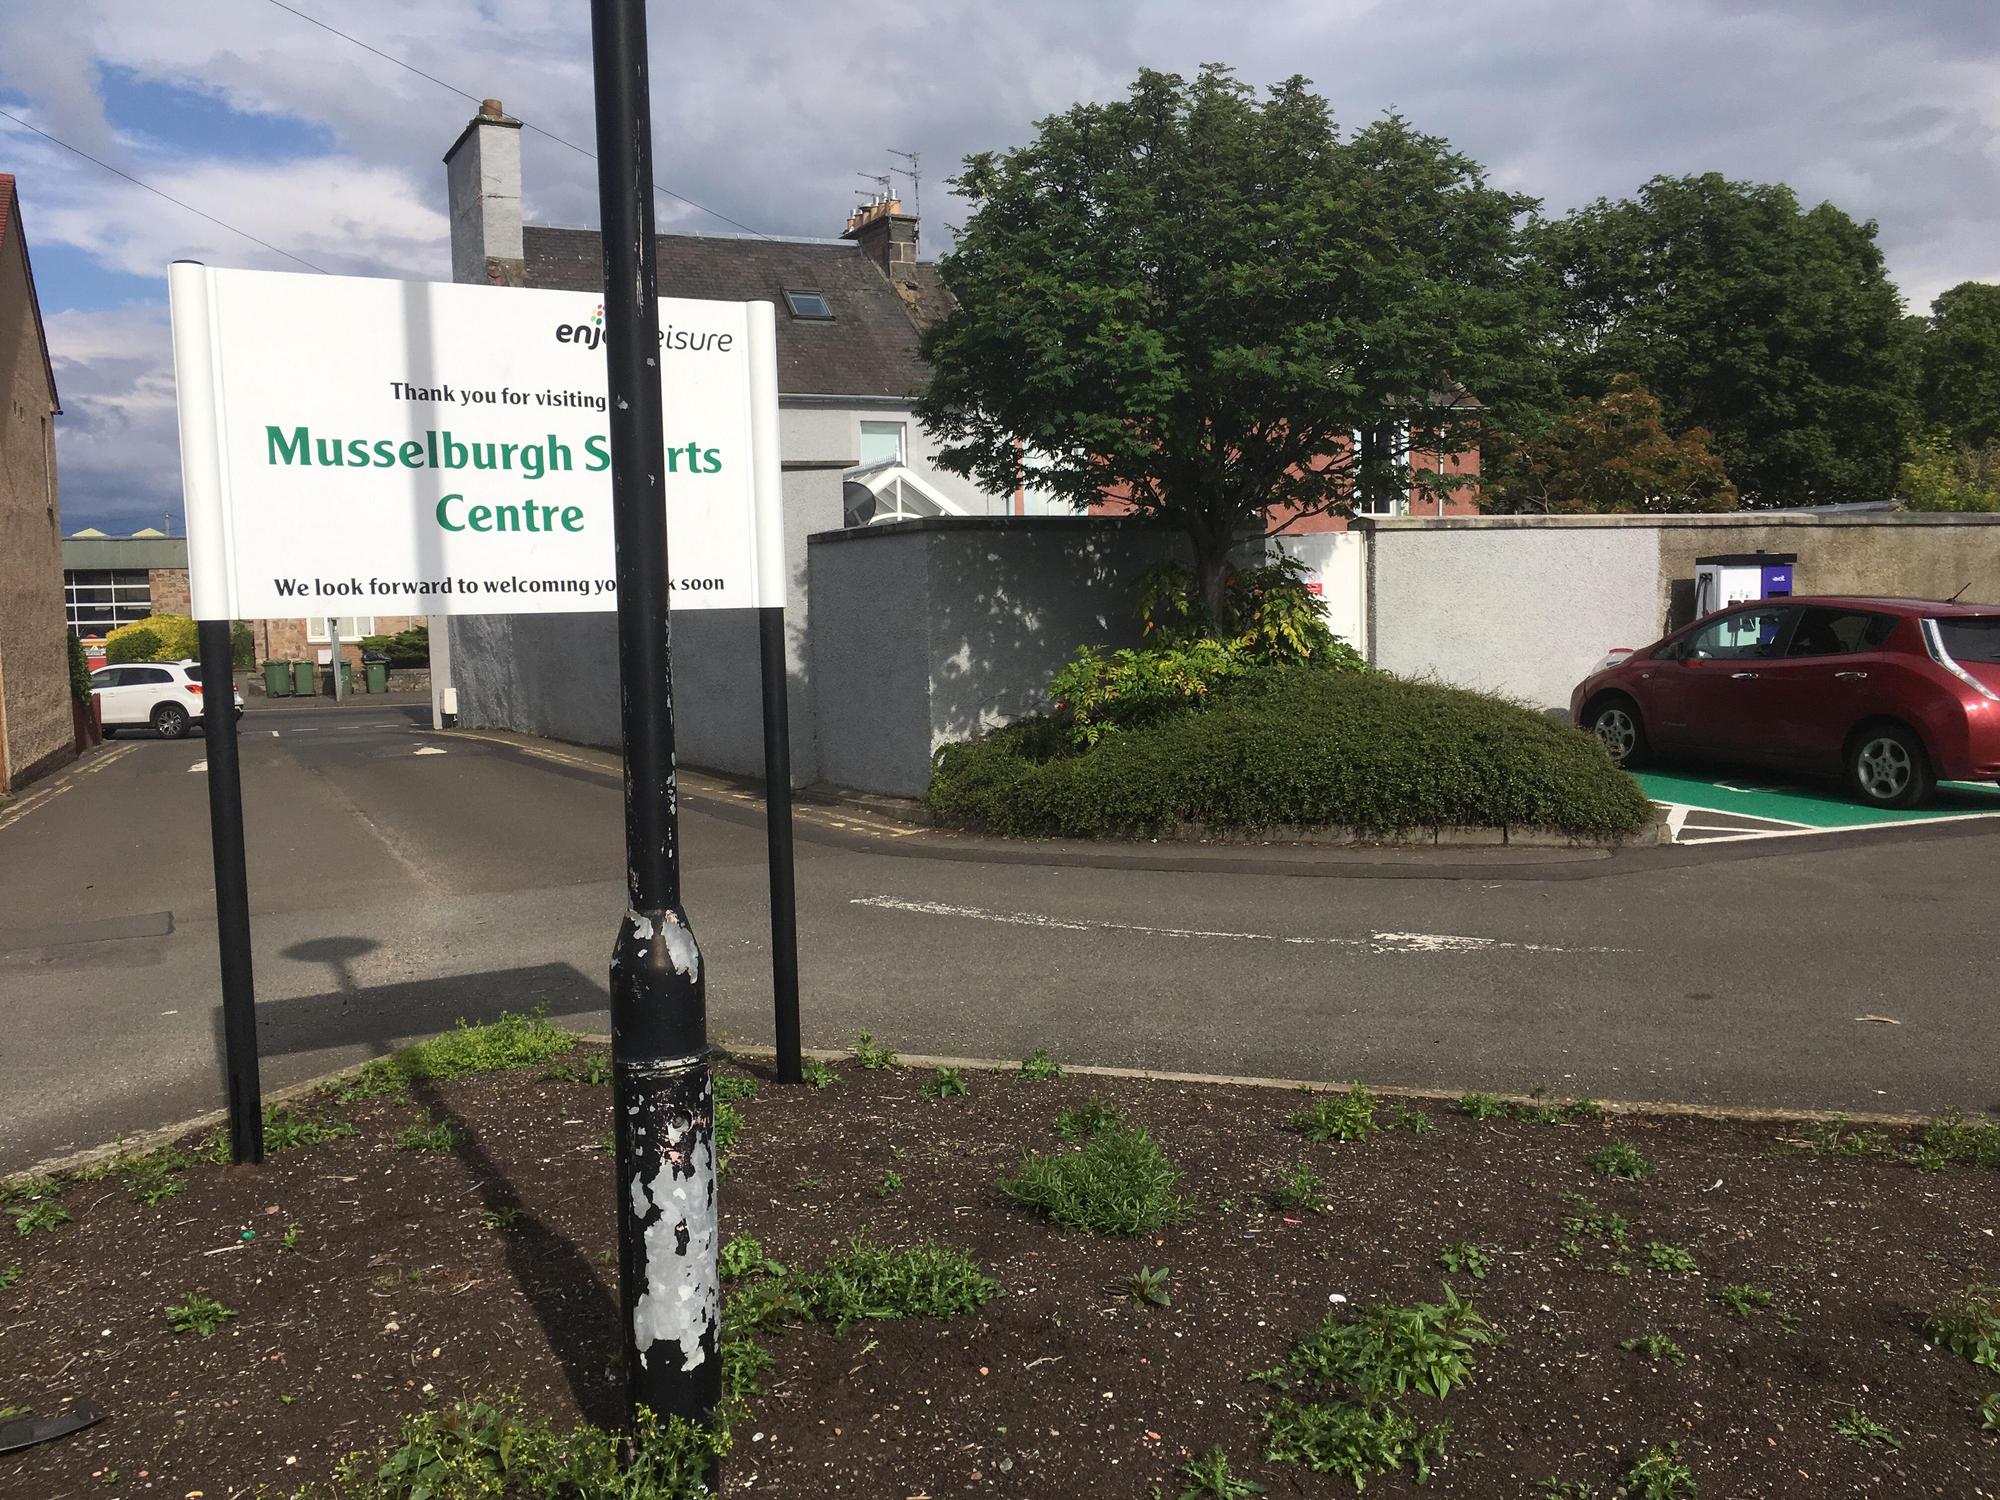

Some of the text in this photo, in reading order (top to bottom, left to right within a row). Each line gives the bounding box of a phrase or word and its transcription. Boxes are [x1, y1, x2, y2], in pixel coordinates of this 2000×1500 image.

[390, 382, 607, 412] Thank you for visiting
[265, 425, 723, 480] Musselburgh Srts
[435, 493, 585, 533] Centre
[274, 578, 309, 597] We
[314, 577, 364, 596] look
[369, 576, 453, 595] forward
[457, 578, 479, 594] to
[483, 576, 590, 596] welcoming
[594, 578, 617, 596] yo
[681, 577, 725, 591] soon
